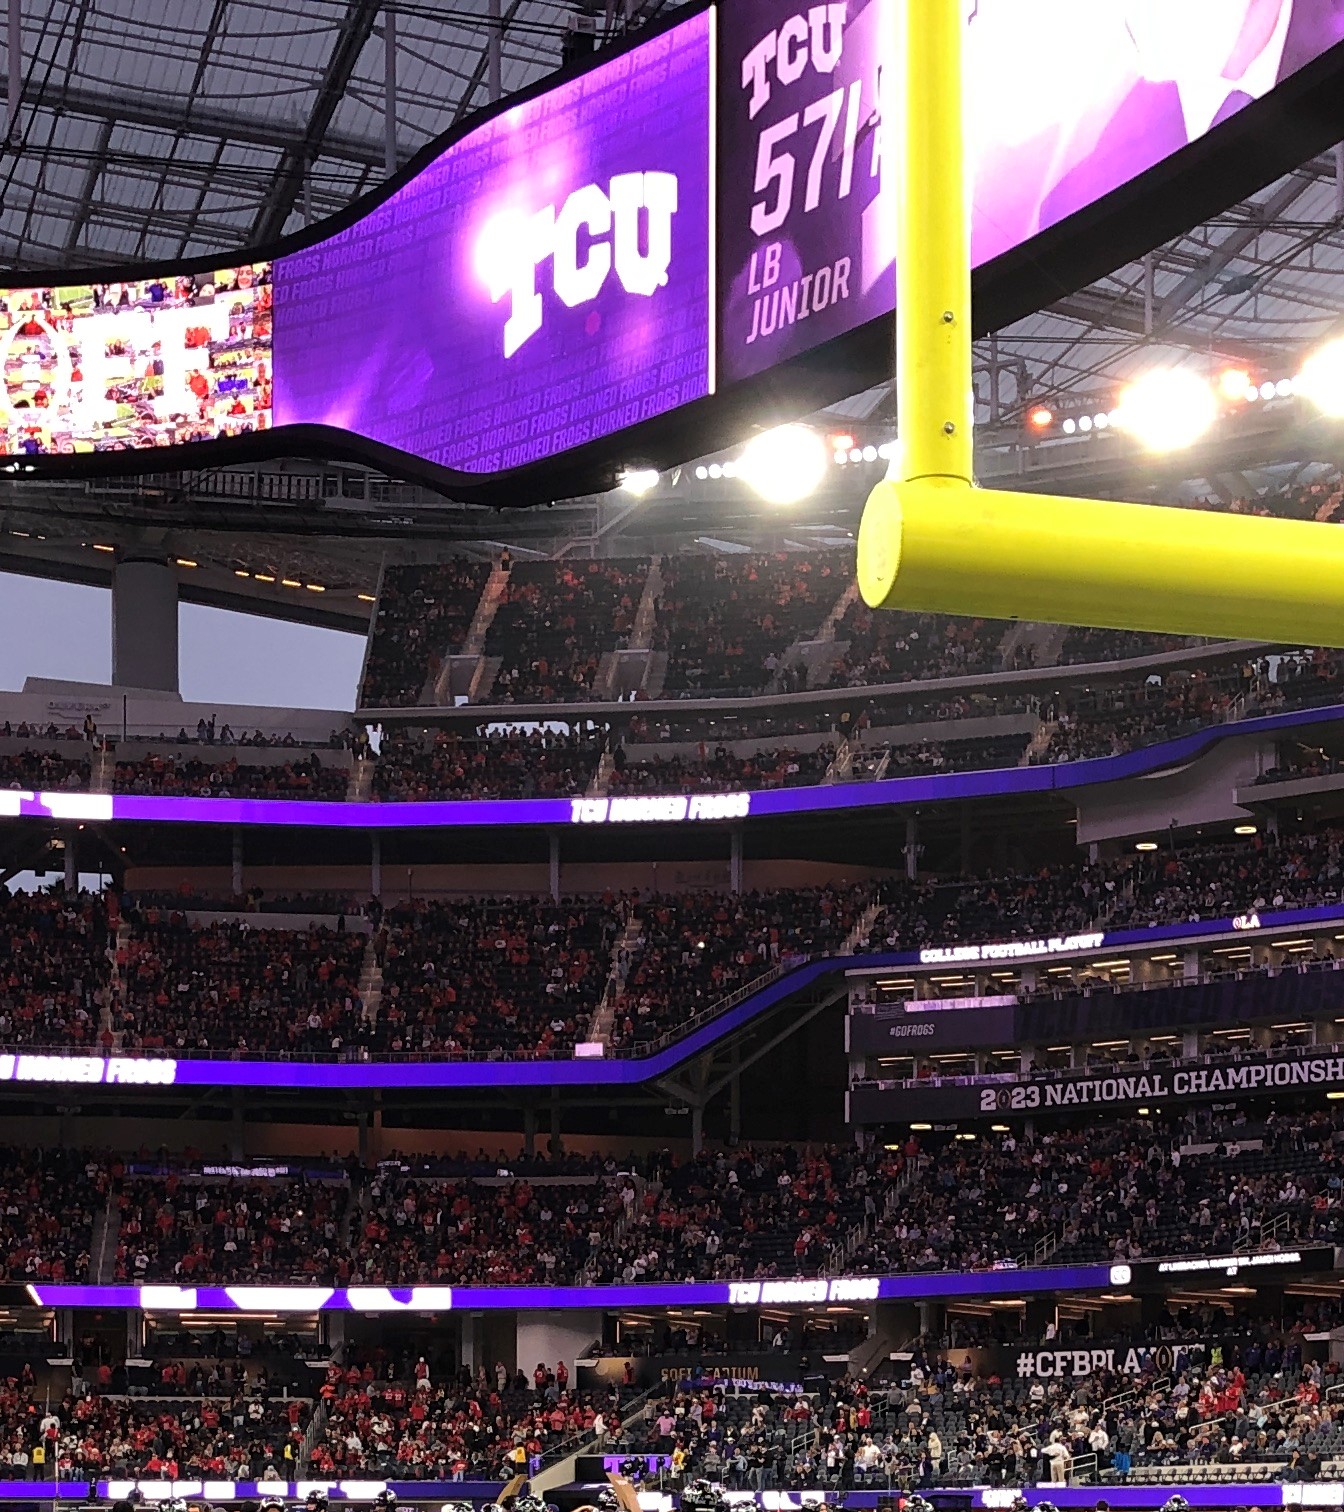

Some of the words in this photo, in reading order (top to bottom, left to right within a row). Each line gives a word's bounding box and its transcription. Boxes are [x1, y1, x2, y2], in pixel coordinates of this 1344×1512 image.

[741, 2, 847, 120] TCU
[478, 171, 678, 359] TCU
[747, 242, 783, 296] LB
[746, 257, 851, 345] JUNIOR
[889, 1022, 935, 1038] #GOFROGS
[1045, 1075, 1168, 1106] NATIONAL
[703, 1366, 759, 1380] TADIUM
